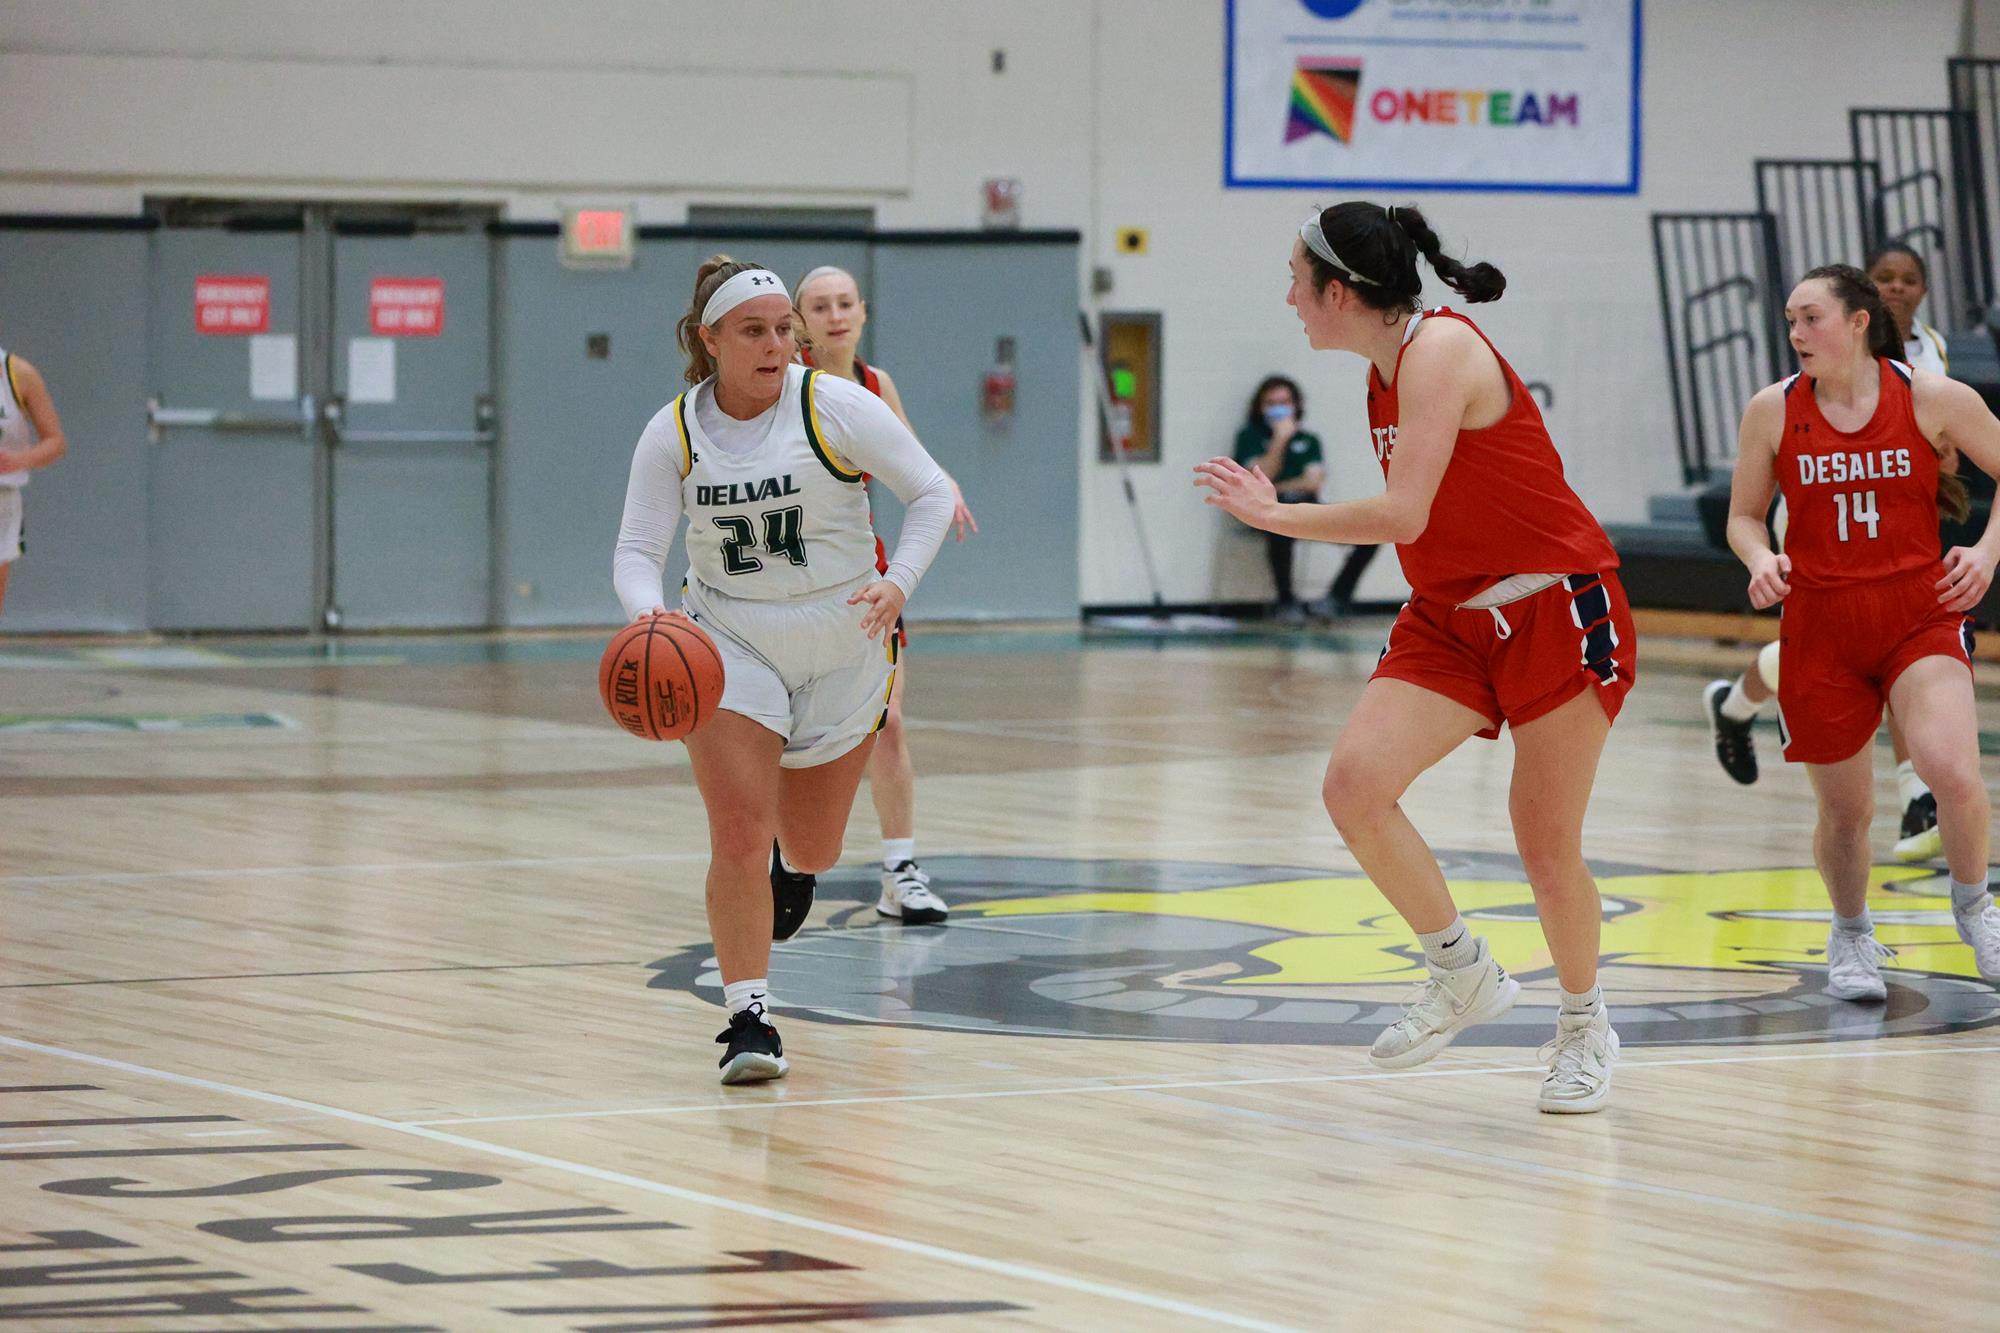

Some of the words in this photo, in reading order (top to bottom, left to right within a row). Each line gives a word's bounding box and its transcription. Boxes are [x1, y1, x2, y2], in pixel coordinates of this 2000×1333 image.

[1370, 89, 1579, 127] ONETEAM
[696, 474, 801, 506] DELVAL
[712, 505, 807, 575] 24
[1833, 490, 1880, 542] 14
[615, 659, 639, 707] ROCK
